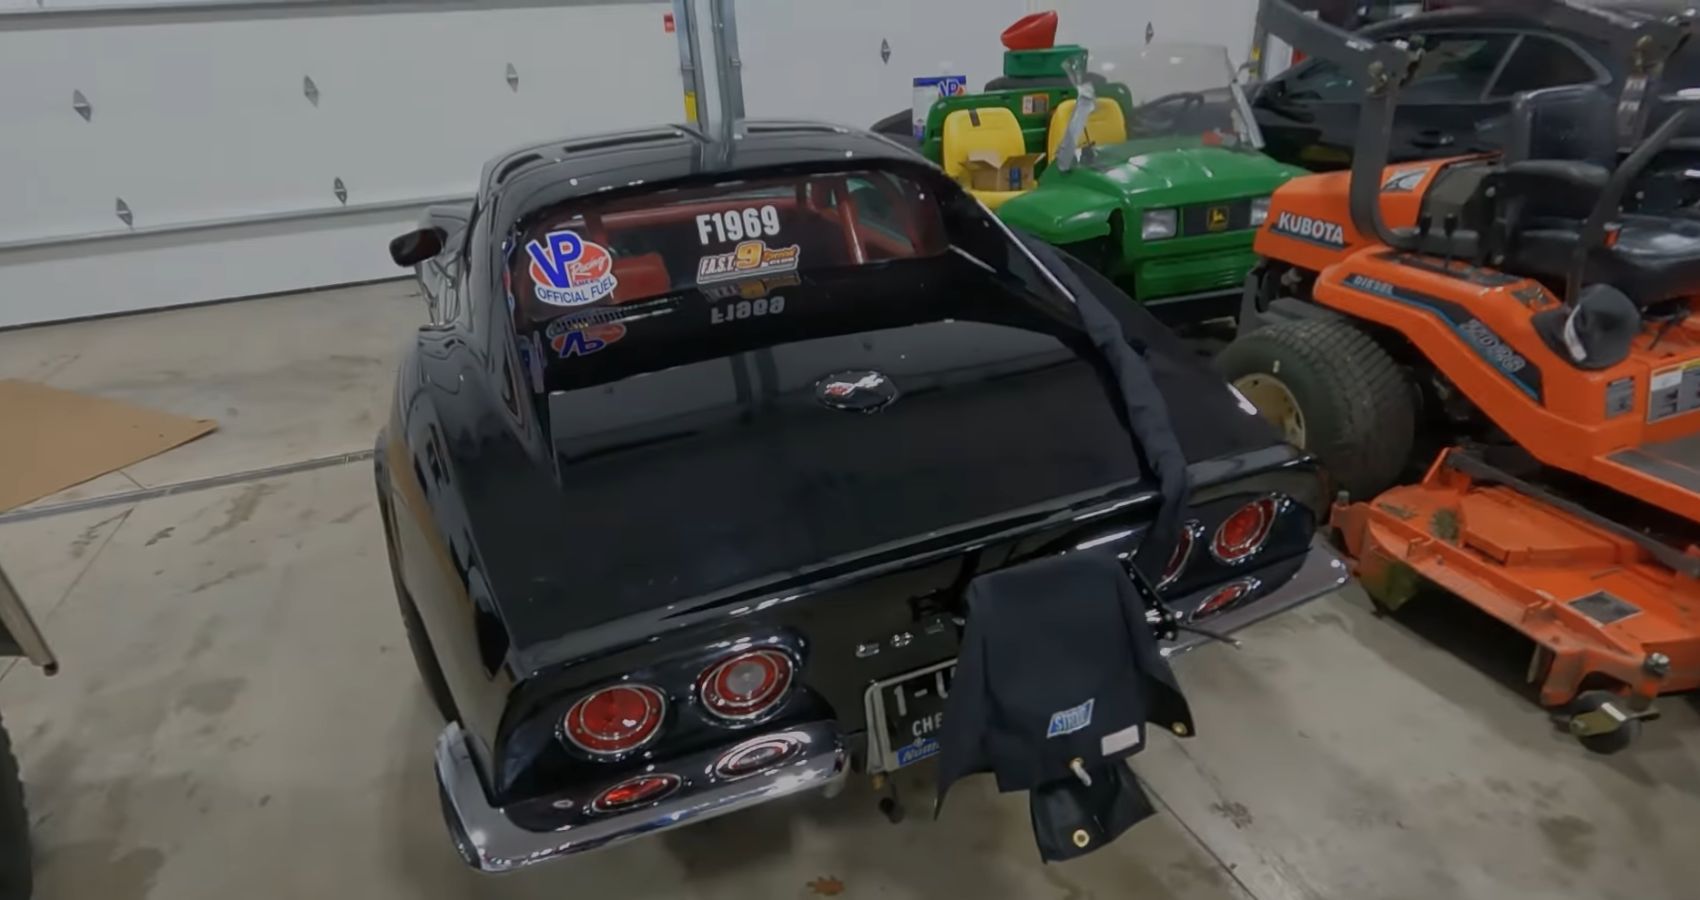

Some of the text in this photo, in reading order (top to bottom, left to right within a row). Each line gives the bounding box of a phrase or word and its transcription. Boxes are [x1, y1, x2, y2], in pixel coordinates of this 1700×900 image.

[696, 205, 780, 245] F1969
[1278, 211, 1344, 245] KUBOTA
[525, 230, 583, 289] VP
[736, 241, 763, 270] 9
[537, 276, 615, 304] OFFICIAL FUEL
